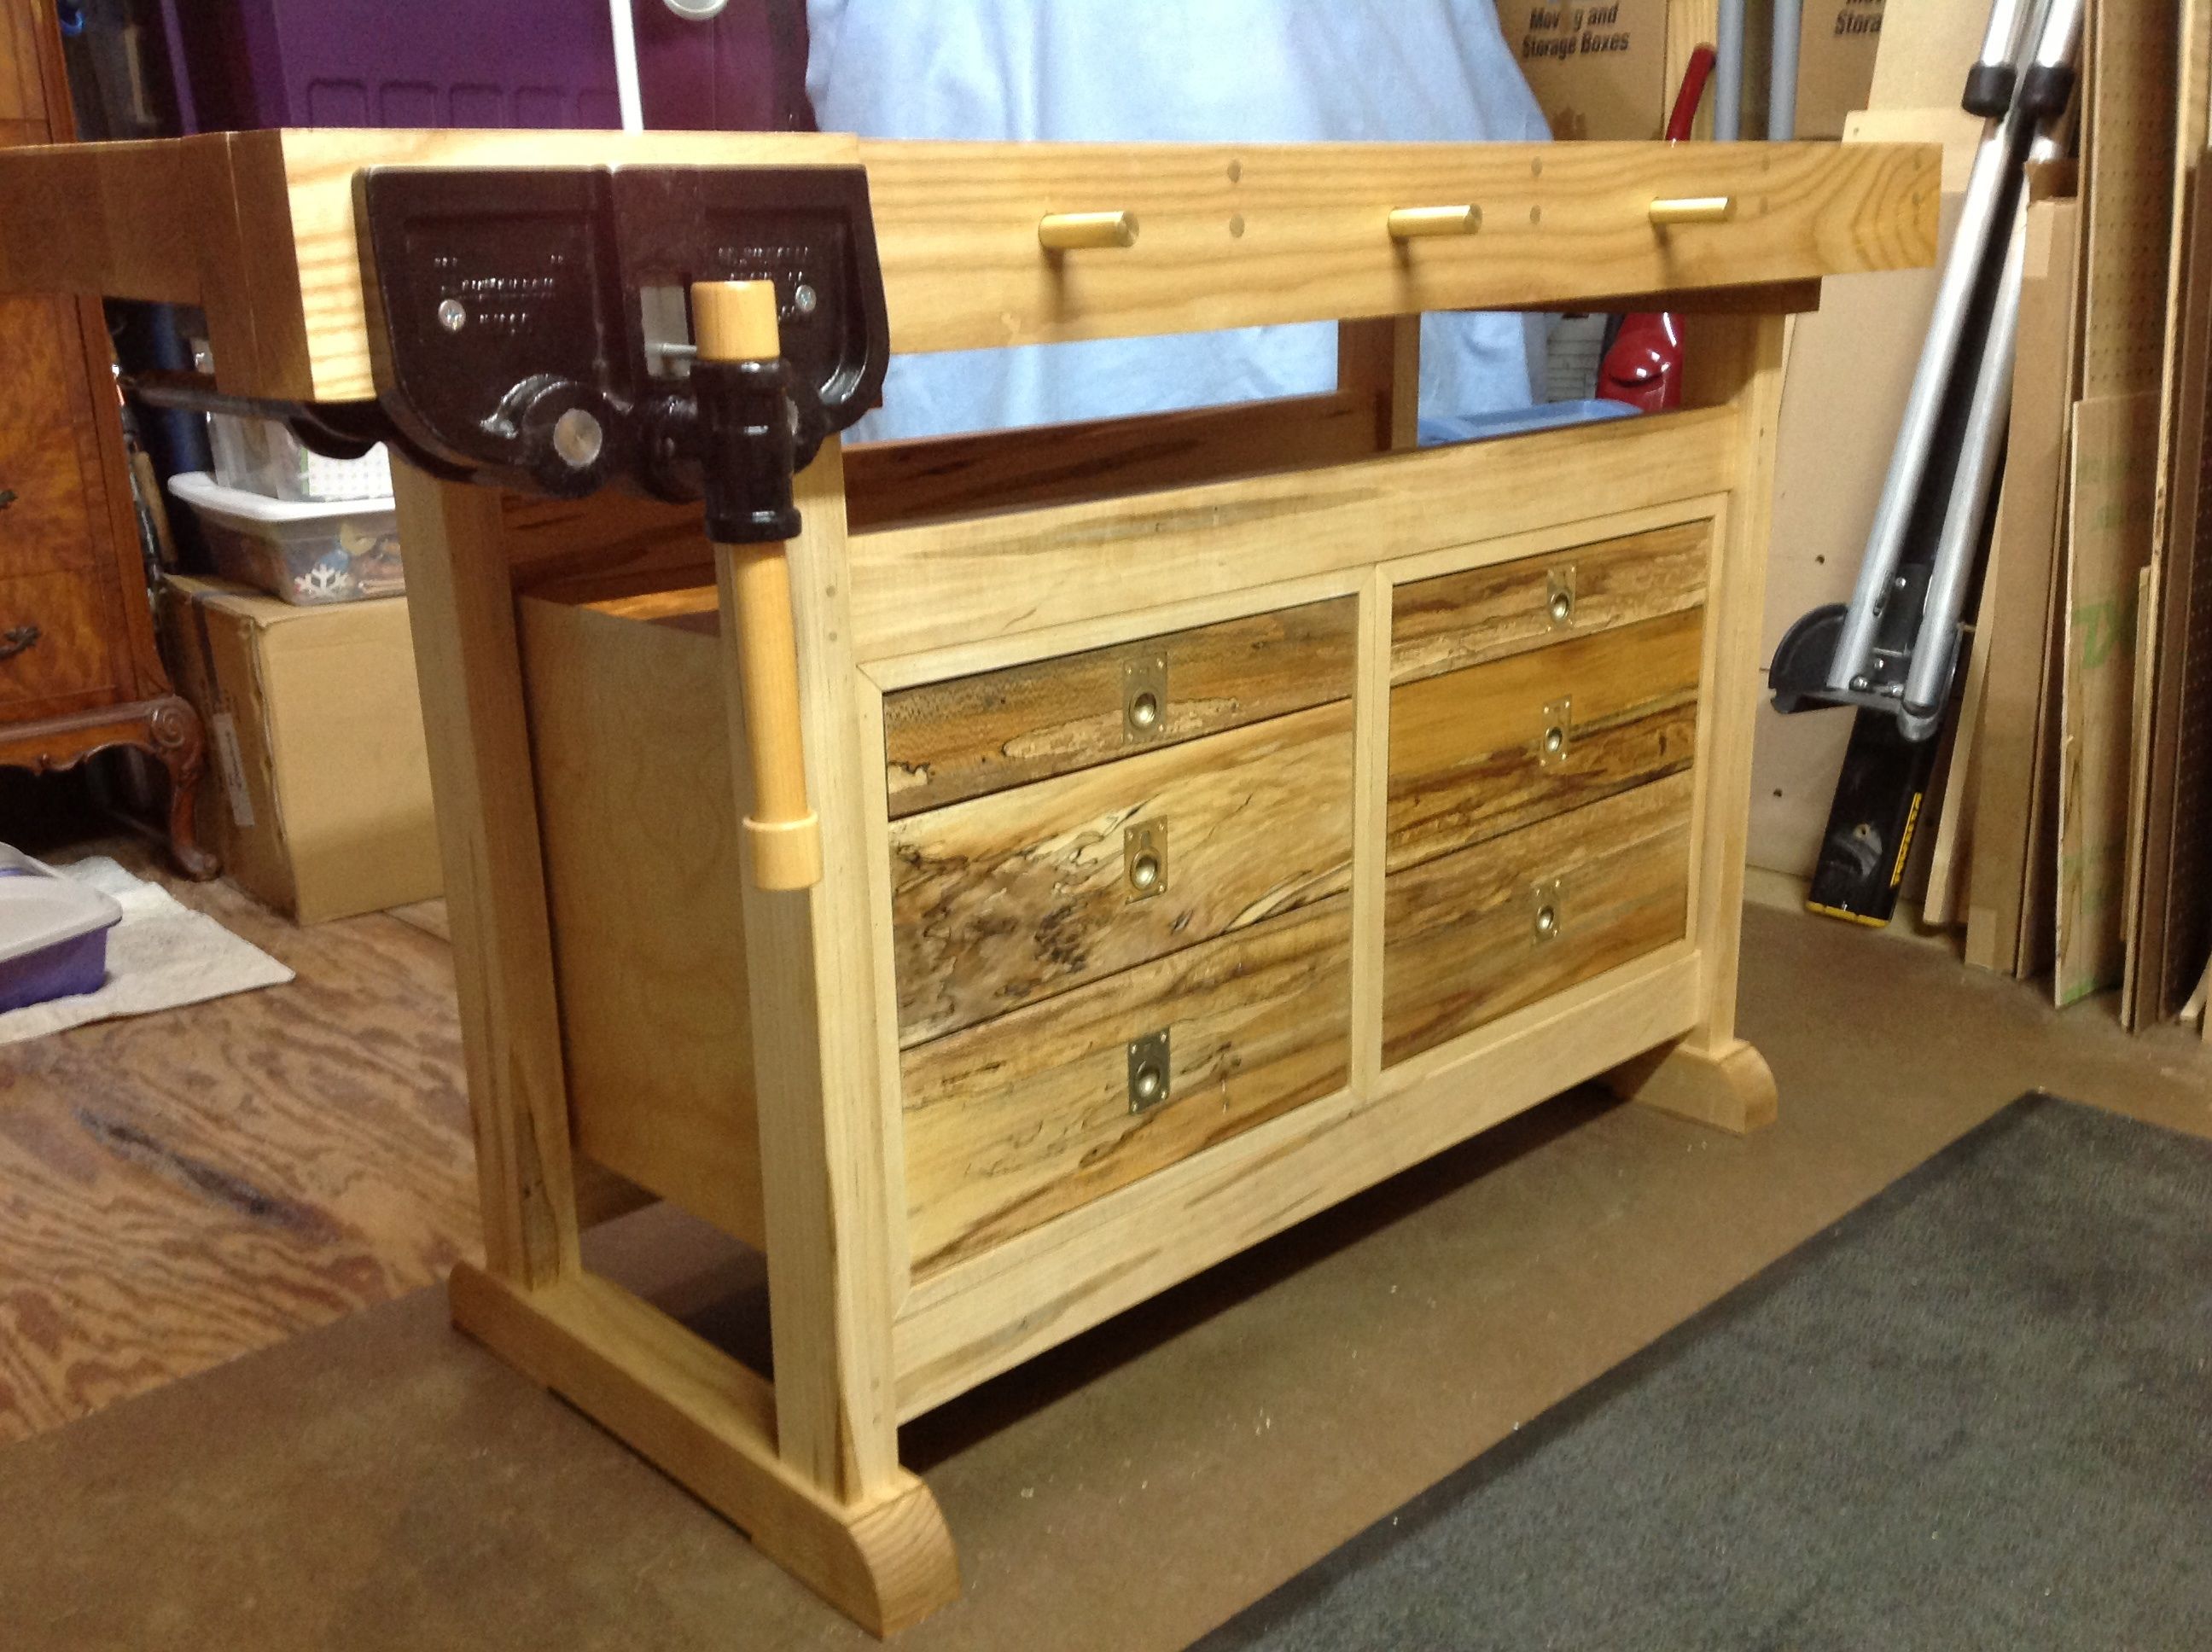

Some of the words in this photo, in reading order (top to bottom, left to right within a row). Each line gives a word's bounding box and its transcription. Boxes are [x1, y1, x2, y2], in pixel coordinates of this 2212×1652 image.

[1530, 8, 1584, 32] Movg
[1587, 2, 1619, 25] and
[1835, 10, 1883, 35] Stora
[1522, 34, 1577, 60] Storage
[1580, 31, 1630, 54] Boxes
